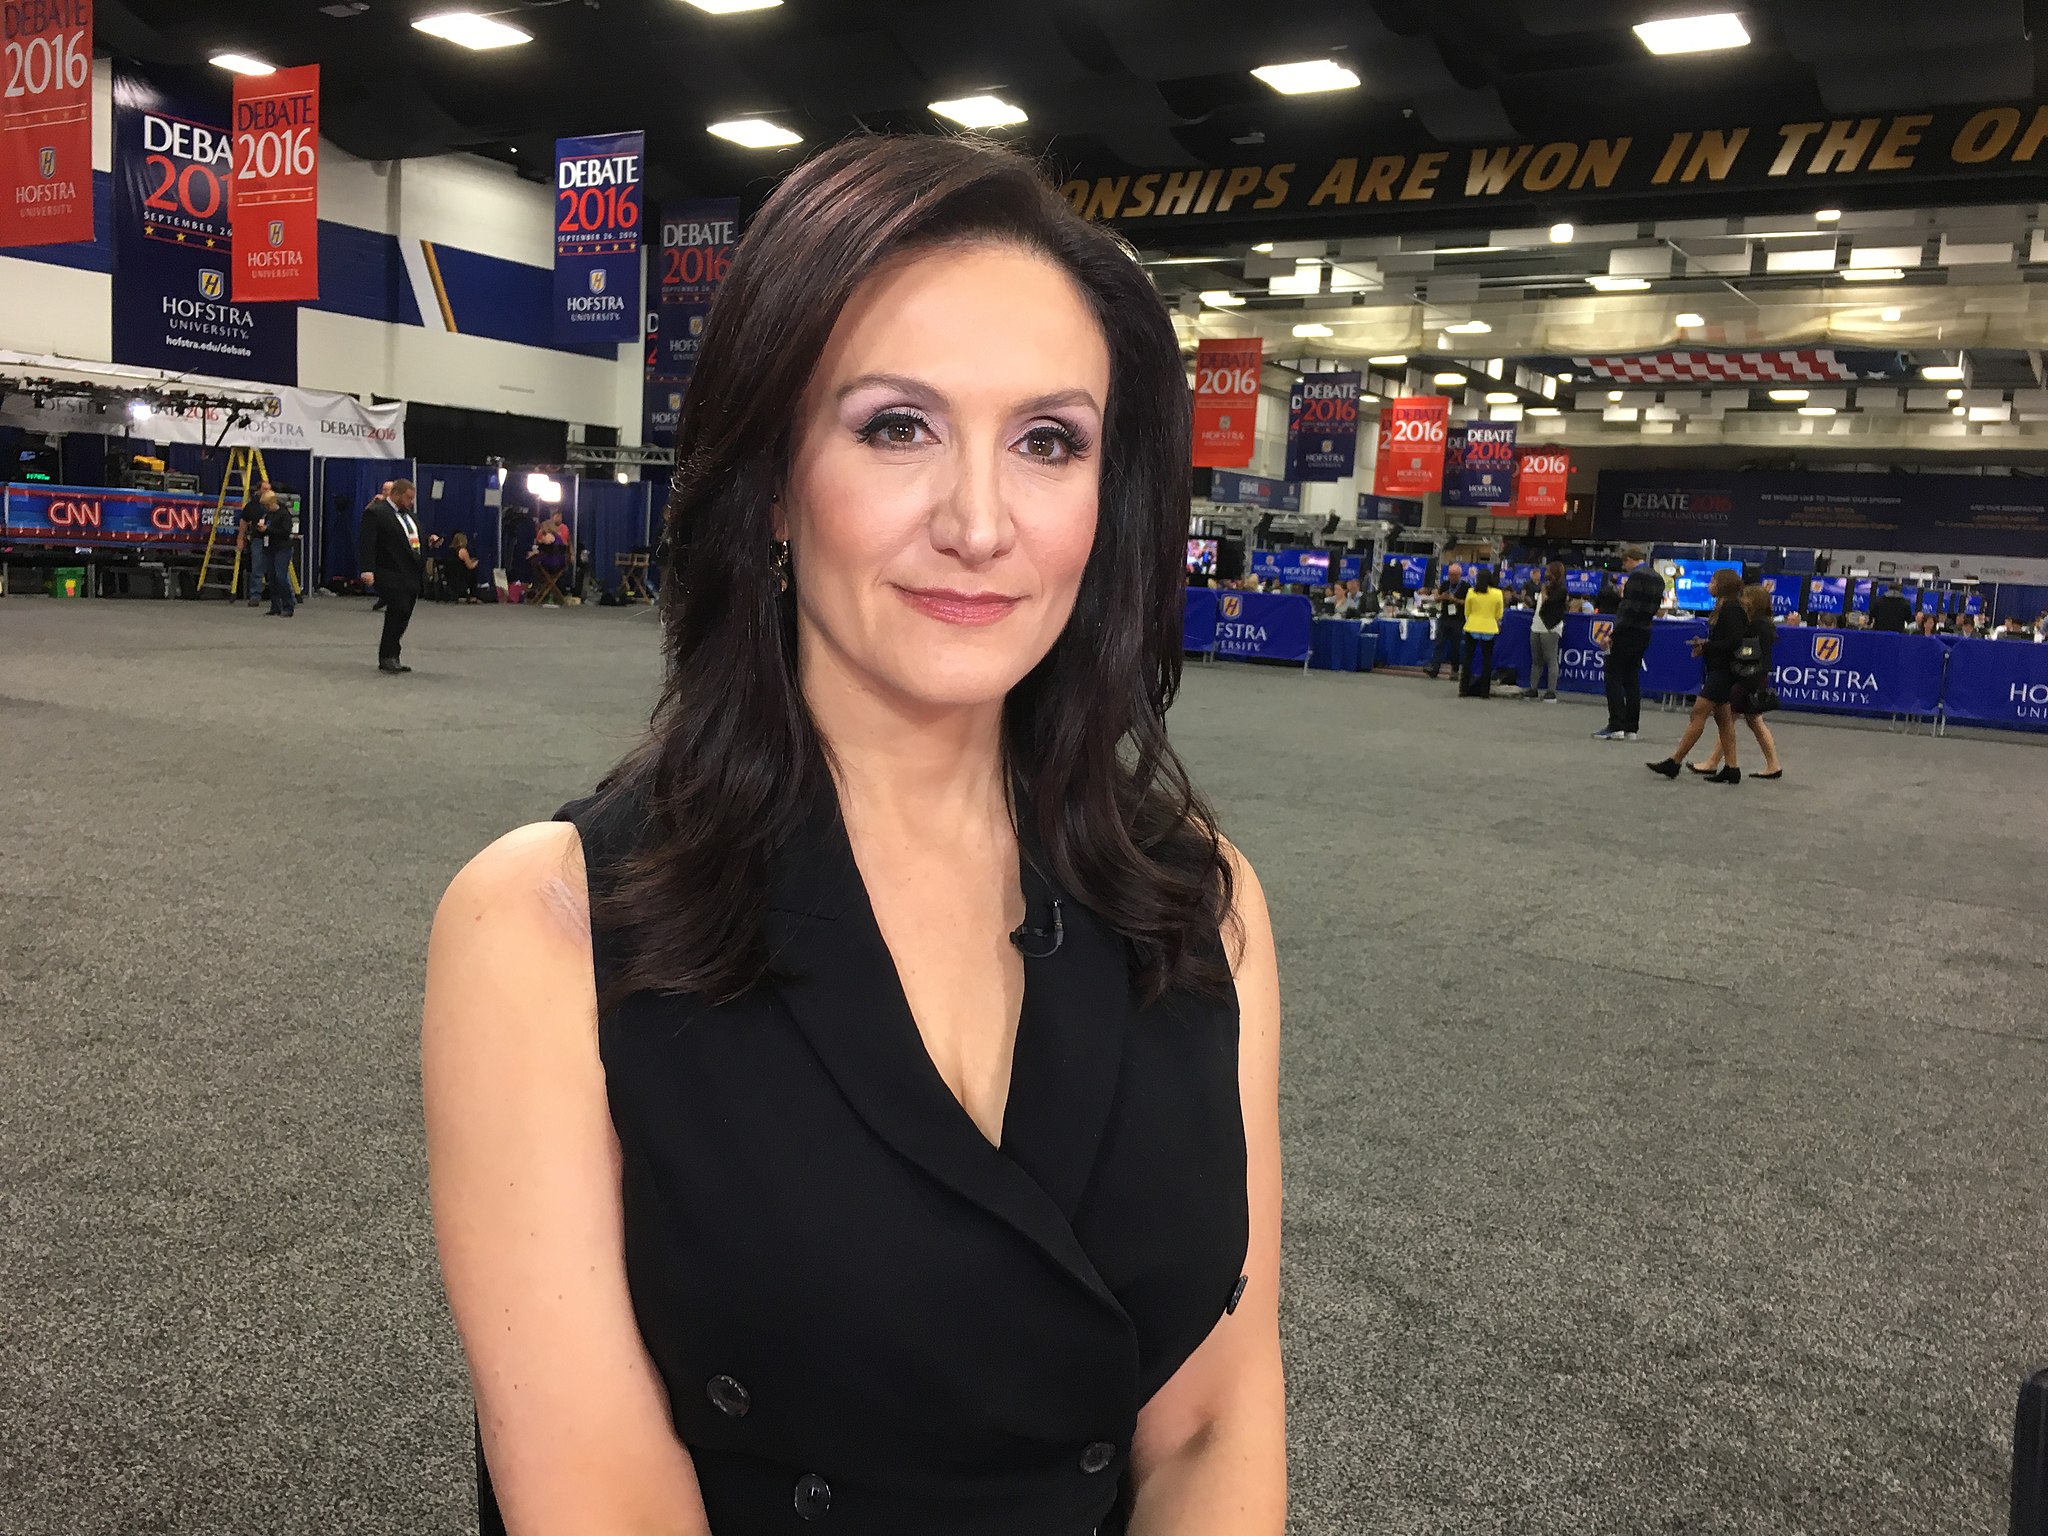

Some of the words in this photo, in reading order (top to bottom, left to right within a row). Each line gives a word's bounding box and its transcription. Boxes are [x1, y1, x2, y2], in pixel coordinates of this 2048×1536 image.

[4, 30, 88, 98] 2016
[237, 95, 315, 131] DEBATE
[143, 114, 234, 170] DEBA
[237, 127, 315, 180] 2016
[558, 155, 640, 189] DEBATE
[1060, 163, 1296, 219] ONSHIPS
[1308, 151, 1449, 206] ARE
[1464, 137, 1633, 197] WON
[1650, 127, 1751, 185] IN
[1767, 114, 1934, 176] THE
[15, 181, 76, 204] HOFSTRA
[20, 204, 73, 218] UNIVERSITY
[558, 184, 639, 231] 2016
[143, 210, 213, 233] SEPTEMBER
[663, 221, 735, 247] DEBATE
[247, 250, 303, 268] HOFSTRA
[662, 245, 732, 284] 2016
[251, 268, 300, 279] UNIVERSITY
[162, 296, 254, 328] HOFSTRA
[567, 296, 625, 311] HOFSTRA
[169, 318, 247, 340] UNIVERSITY
[165, 335, 252, 357] hofstra.edu/debate
[1198, 368, 1257, 395] 2016
[1303, 383, 1357, 399] DEBATE
[1303, 398, 1356, 421] 2016
[320, 420, 368, 437] DEBATE
[367, 428, 396, 441] 2016
[1393, 420, 1444, 442] 2016
[1467, 429, 1514, 442] DEBATE
[1466, 441, 1513, 460] 2016
[1523, 455, 1566, 474] 2016
[1622, 492, 1690, 511] DEBATE
[49, 501, 100, 527] CNN
[153, 507, 198, 531] CNN
[1283, 566, 1323, 577] HOFSTRA
[1560, 668, 1605, 681] NIVER
